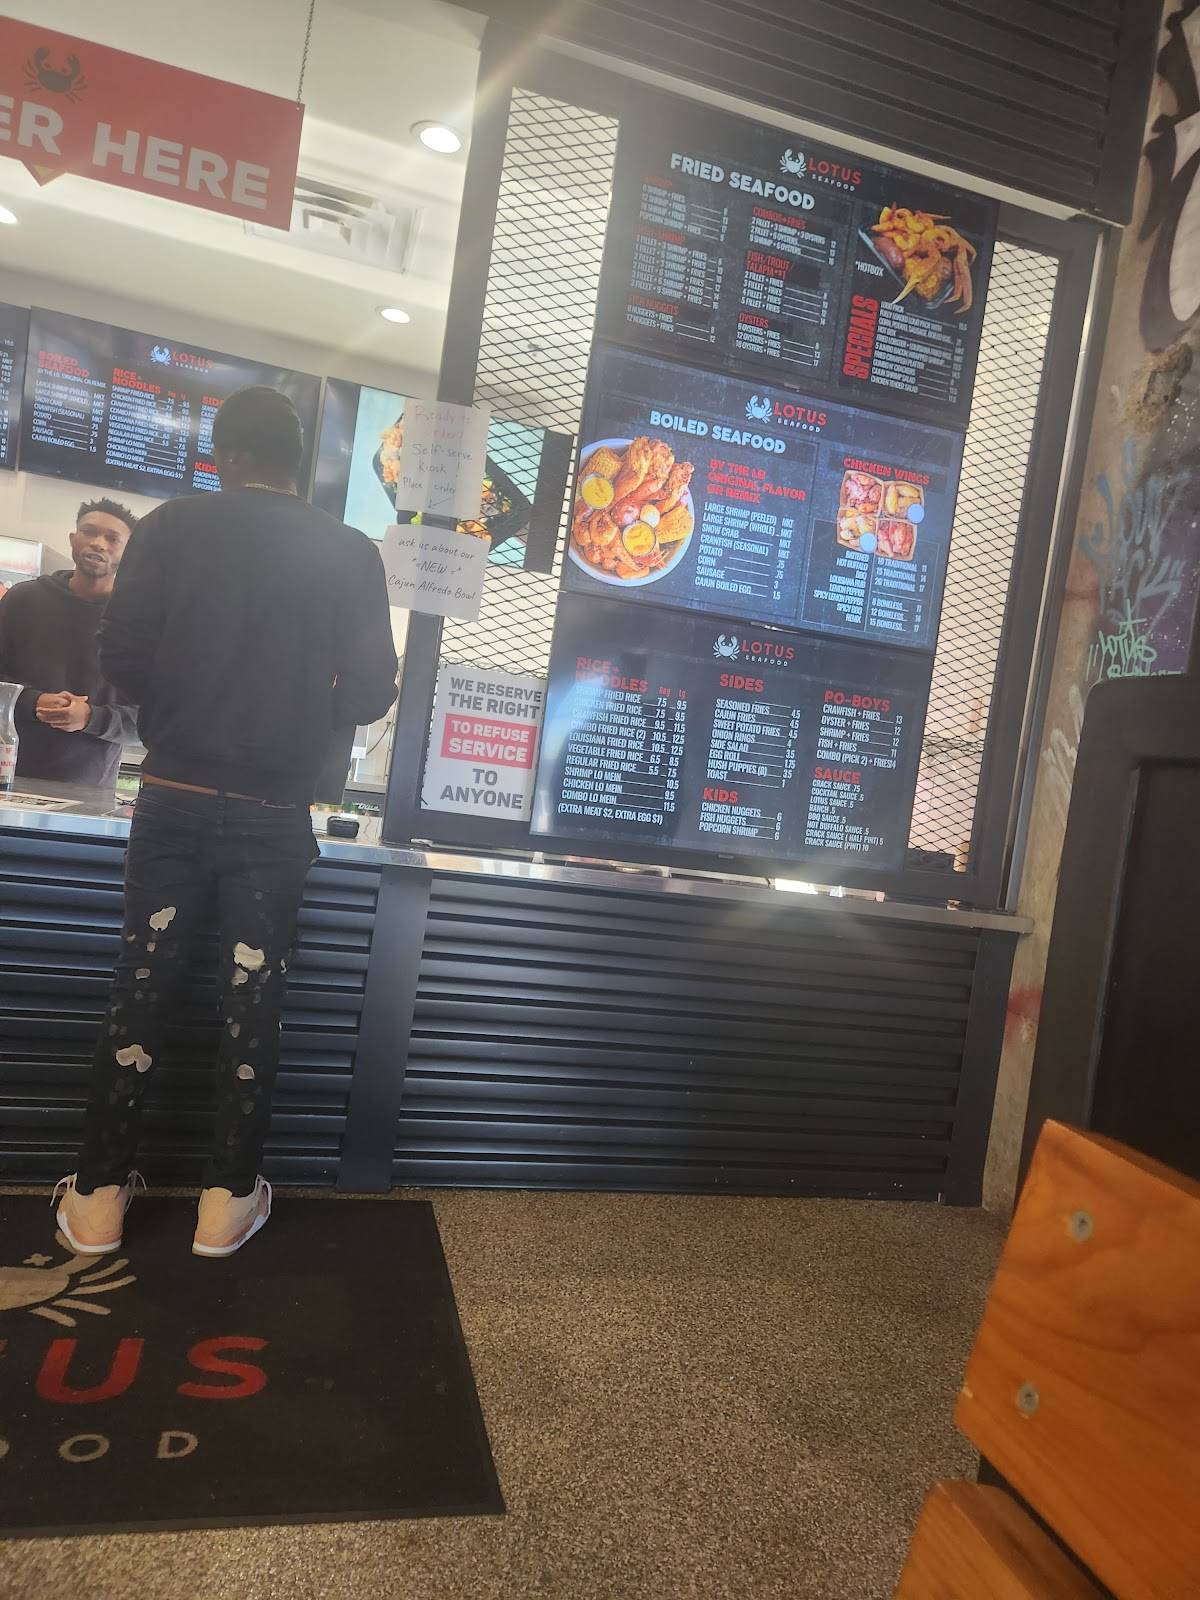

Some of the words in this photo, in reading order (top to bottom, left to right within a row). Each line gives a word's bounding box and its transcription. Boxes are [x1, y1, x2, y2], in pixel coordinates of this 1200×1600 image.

[92, 121, 270, 210] HERE
[808, 157, 862, 185] LOTUS
[670, 152, 725, 184] FRIED
[727, 170, 815, 211] SEAFOOD
[811, 174, 855, 192] SEAFOOD
[749, 272, 764, 282] FILLET
[769, 277, 783, 287] FRIES
[745, 298, 761, 308] FILLET
[765, 303, 780, 313] FRIES
[739, 312, 768, 328] OYSTERS
[843, 294, 878, 380] SPECIALS
[172, 351, 213, 369] LOTUS
[113, 367, 137, 380] RICE
[111, 376, 160, 393] NOODLES
[772, 400, 828, 426] LOTUS
[649, 410, 709, 437] BOILED
[710, 424, 786, 455] SEAFOOD
[776, 417, 820, 433] SEAFOOD
[194, 461, 218, 473] KIDS
[726, 462, 749, 476] THE
[843, 456, 891, 476] CHICKEN
[893, 468, 929, 485] WINGS
[707, 471, 758, 491] ORIGINAL
[761, 482, 805, 501] FLAVOR
[704, 502, 725, 514] LARGE
[725, 506, 750, 519] SHRIMP
[750, 511, 777, 525] (PEELED)
[701, 523, 721, 534] SNOW
[721, 527, 739, 538] CRAB
[702, 512, 723, 524] LARGE
[723, 516, 749, 529] SHRIMP
[749, 522, 775, 536] (WHOLE)
[399, 538, 416, 547] ask
[432, 544, 458, 557] about
[461, 552, 476, 560] our
[698, 544, 722, 556] POTATO
[699, 533, 733, 548] CRAWFISH
[733, 540, 768, 556] (SEASONAL)
[697, 555, 716, 566] CORN
[696, 565, 725, 578] SAUSAGE
[388, 574, 415, 588] Cajun
[417, 580, 452, 595] Alfredo
[455, 587, 476, 600] Bowl
[694, 576, 715, 588] CAJUN
[715, 580, 738, 592] BOILED
[740, 639, 794, 659] LOTUS
[575, 656, 610, 673] RICE
[745, 655, 788, 666] SEAFOOD
[451, 677, 474, 692] WE
[477, 681, 542, 702] RESERVE
[719, 673, 764, 692] SIDES
[448, 692, 483, 711] THE
[486, 698, 540, 719] RIGHT
[624, 692, 641, 703] RICE
[656, 697, 667, 707] 7.5
[676, 700, 686, 710] 9.5
[715, 698, 750, 711] SEASONED
[751, 703, 769, 714] FRIES
[791, 709, 800, 719] 4.5
[823, 690, 890, 712] PO-BOYS
[609, 714, 629, 724] FRIED
[629, 717, 646, 727] RICE
[714, 708, 736, 720] CAJUN
[737, 712, 756, 723] FRIES
[822, 704, 856, 717] CRAWFISH
[862, 710, 880, 720] FRIES
[712, 719, 734, 730] SWEET
[735, 722, 760, 733] POTATO
[761, 726, 780, 736] FRIES
[821, 715, 845, 727] OYSTER
[851, 720, 870, 730] FRIES
[451, 720, 471, 734] TO
[473, 723, 530, 743] REFUSE
[569, 731, 606, 744] LOUISIANA
[606, 736, 626, 747] FRIED
[627, 739, 643, 749] RICE
[711, 729, 733, 740] ONION
[733, 732, 755, 743] RINGS
[819, 726, 846, 738] SHRIMP
[851, 731, 869, 742] FRIES
[449, 738, 527, 763] SERVICE
[567, 743, 605, 756] VEGETABLE
[606, 748, 626, 759] FRIED
[626, 751, 643, 761] RICE
[649, 754, 660, 764] 6.5
[710, 739, 725, 749] SIDE
[726, 741, 748, 752] SALAD
[785, 749, 795, 758] 3.5
[818, 738, 833, 748] FISH
[838, 741, 857, 752] FRIES
[566, 755, 598, 767] REGULAR
[599, 759, 619, 770] FRIED
[620, 762, 636, 772] RICE
[708, 749, 722, 759] EGG
[723, 751, 739, 761] ROLL
[816, 749, 840, 760] COMBO
[841, 753, 859, 764] (PICK
[564, 766, 593, 778] SHRIMP
[603, 771, 621, 782] MEIN
[706, 769, 727, 780] TOAST
[707, 759, 727, 769] HUSH
[727, 761, 757, 773] PUPPIES
[472, 768, 498, 786] TO
[814, 766, 860, 784] SAUCE
[562, 778, 594, 790] CHICKEN
[605, 783, 622, 793] MEIN
[664, 790, 675, 800] 9.5
[811, 787, 837, 797] COCKTAIL
[839, 791, 857, 800] SAUCE
[812, 779, 832, 788] CRACK
[832, 781, 851, 791] SAUCE
[440, 785, 524, 809] ANYONE
[561, 789, 587, 801] COMBO
[599, 794, 617, 804] MEIN
[703, 787, 737, 803] KIDS
[810, 796, 828, 804] LOTUS
[828, 798, 847, 807] SAUCE
[558, 803, 583, 814] (EXTRA
[583, 806, 602, 816] MEAT
[614, 810, 636, 820] EXTRA
[637, 812, 651, 822] EGG
[701, 802, 730, 813] CHICKEN
[731, 806, 761, 817] NUGGETS
[809, 804, 829, 813] RANCH
[698, 821, 730, 833] POPCORN
[731, 825, 758, 837] SHRIMP
[819, 822, 843, 831] BUFFALO
